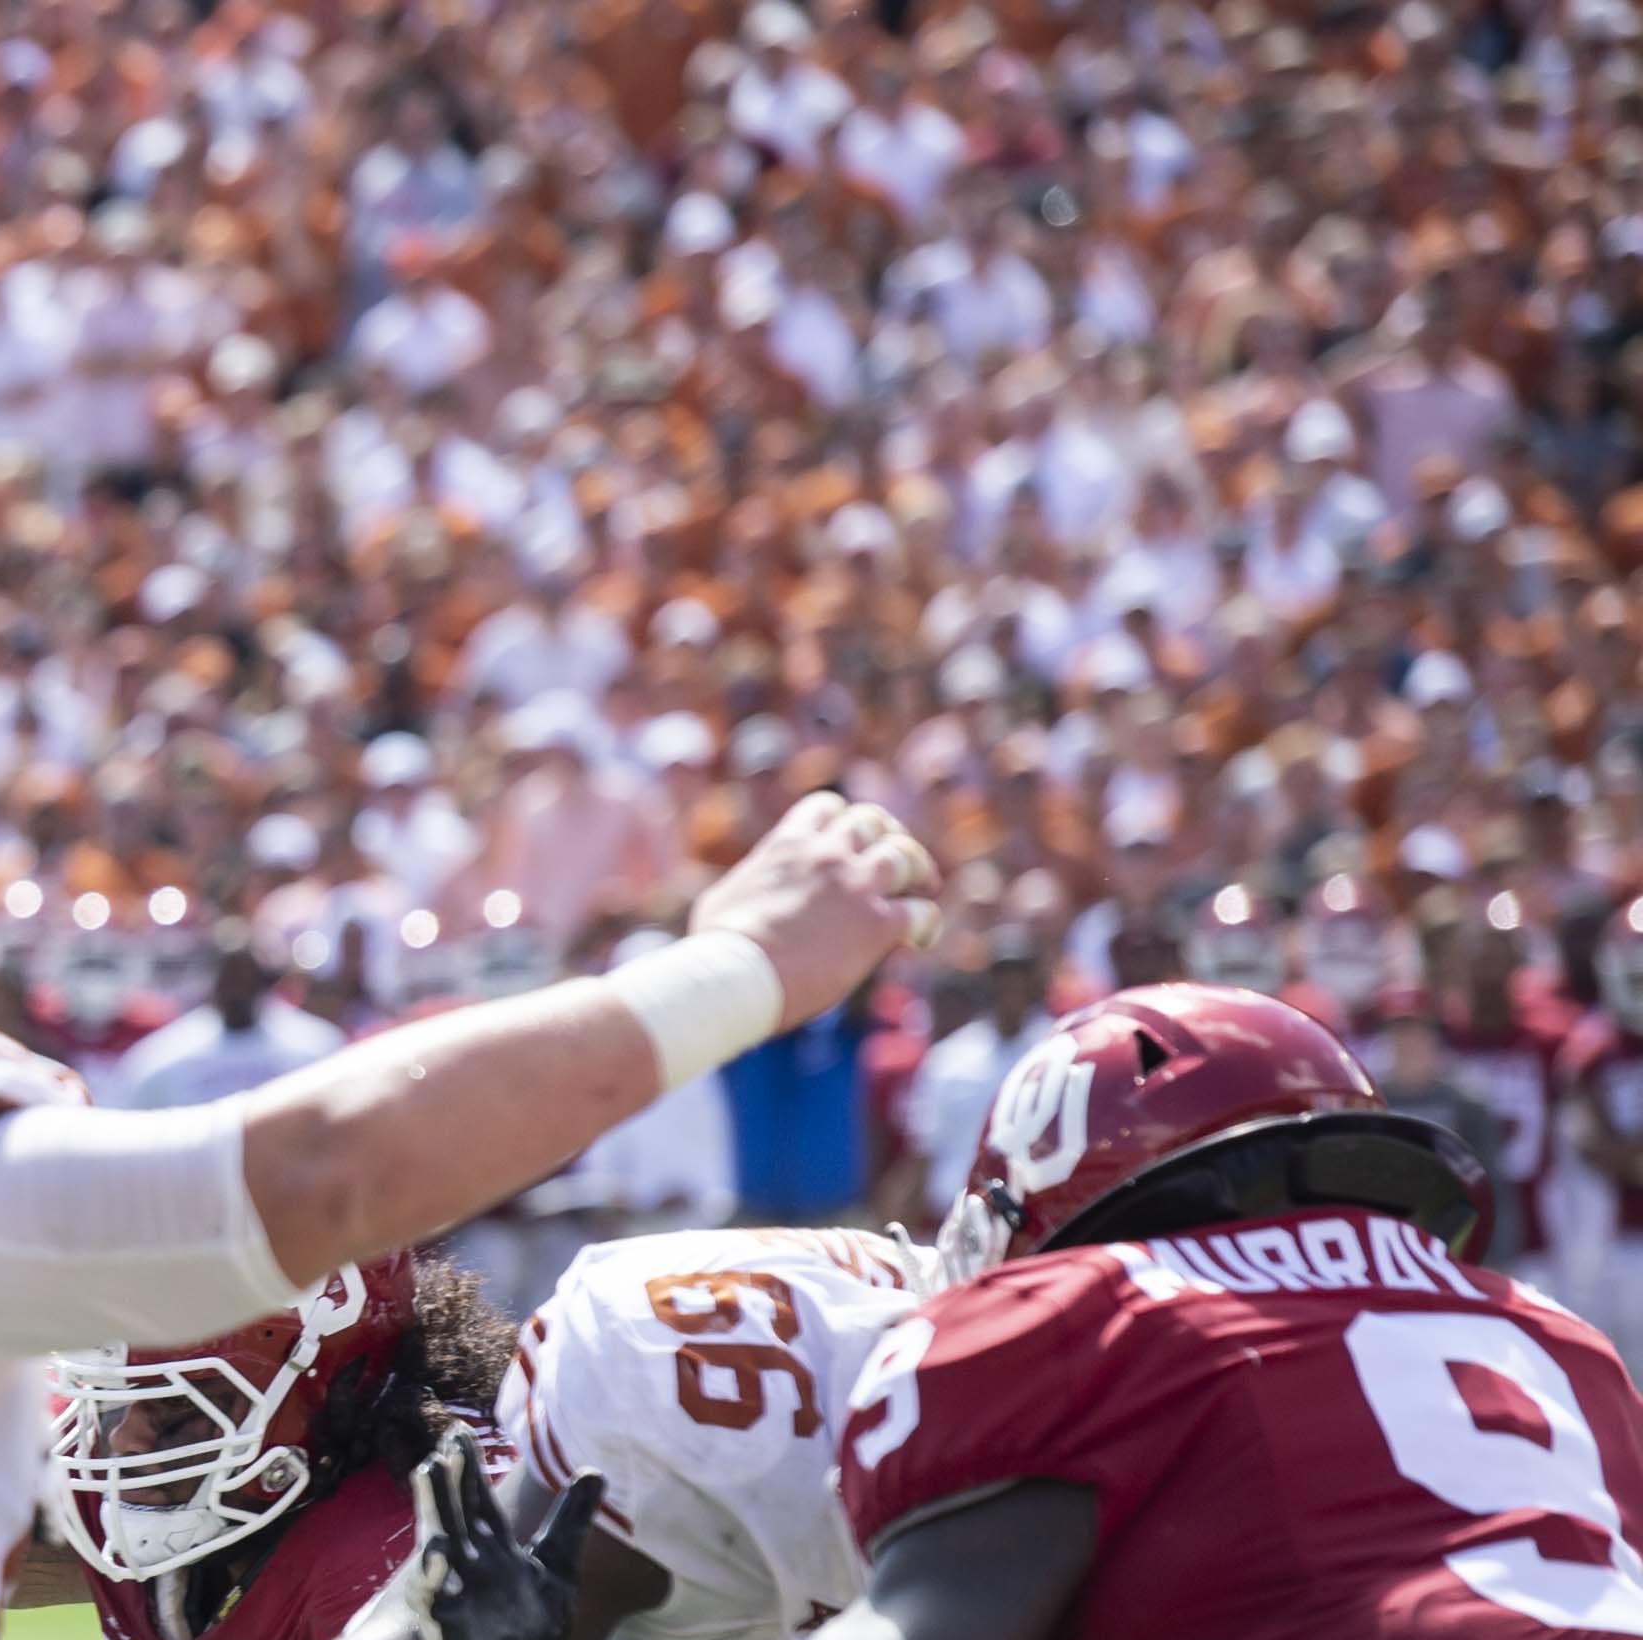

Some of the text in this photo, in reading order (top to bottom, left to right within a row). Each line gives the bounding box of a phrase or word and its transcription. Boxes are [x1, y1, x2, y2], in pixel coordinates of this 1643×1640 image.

[989, 1032, 1096, 1194] OU
[847, 1317, 936, 1471] 9
[1344, 1310, 1643, 1635] 9
